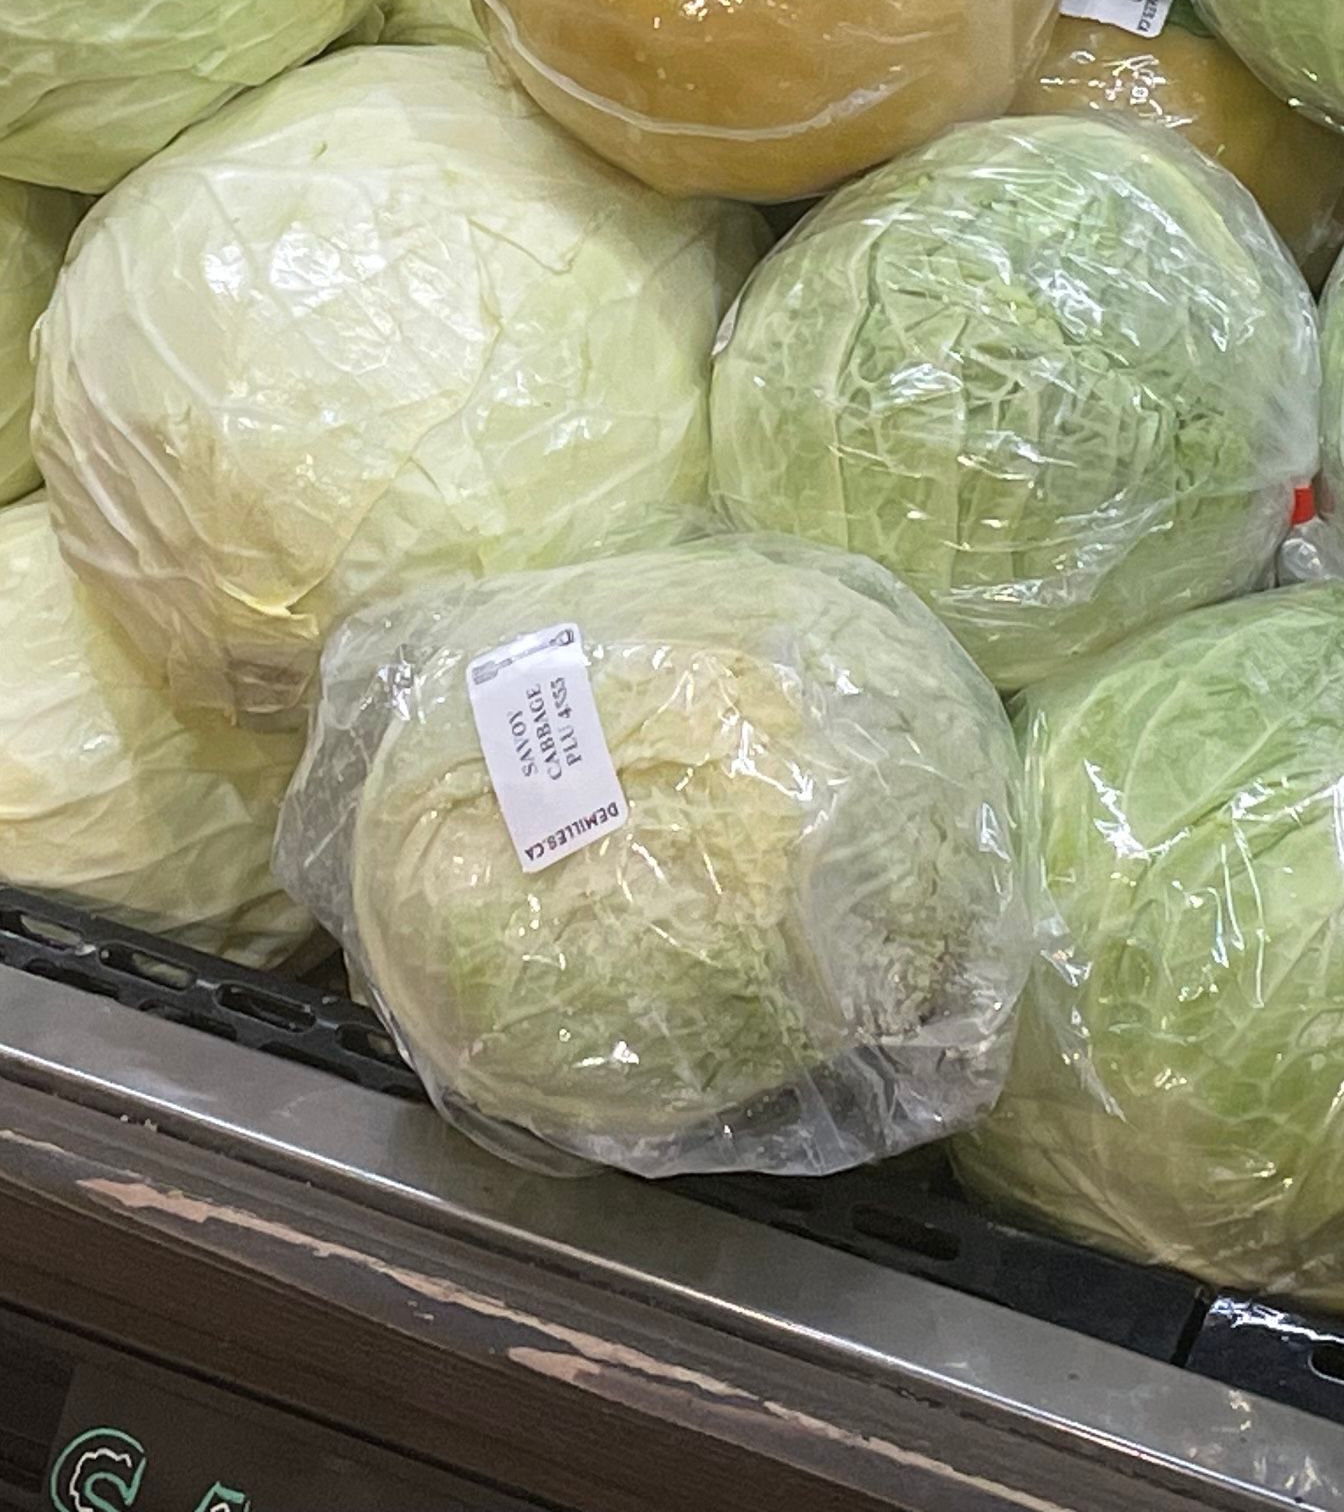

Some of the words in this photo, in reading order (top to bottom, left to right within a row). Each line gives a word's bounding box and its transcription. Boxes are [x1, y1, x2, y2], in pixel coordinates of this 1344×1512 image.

[507, 710, 539, 777] SAVOY
[526, 683, 563, 781] CABBAGE
[558, 724, 583, 767] PLU
[524, 801, 620, 861] DEMILLES.CA
